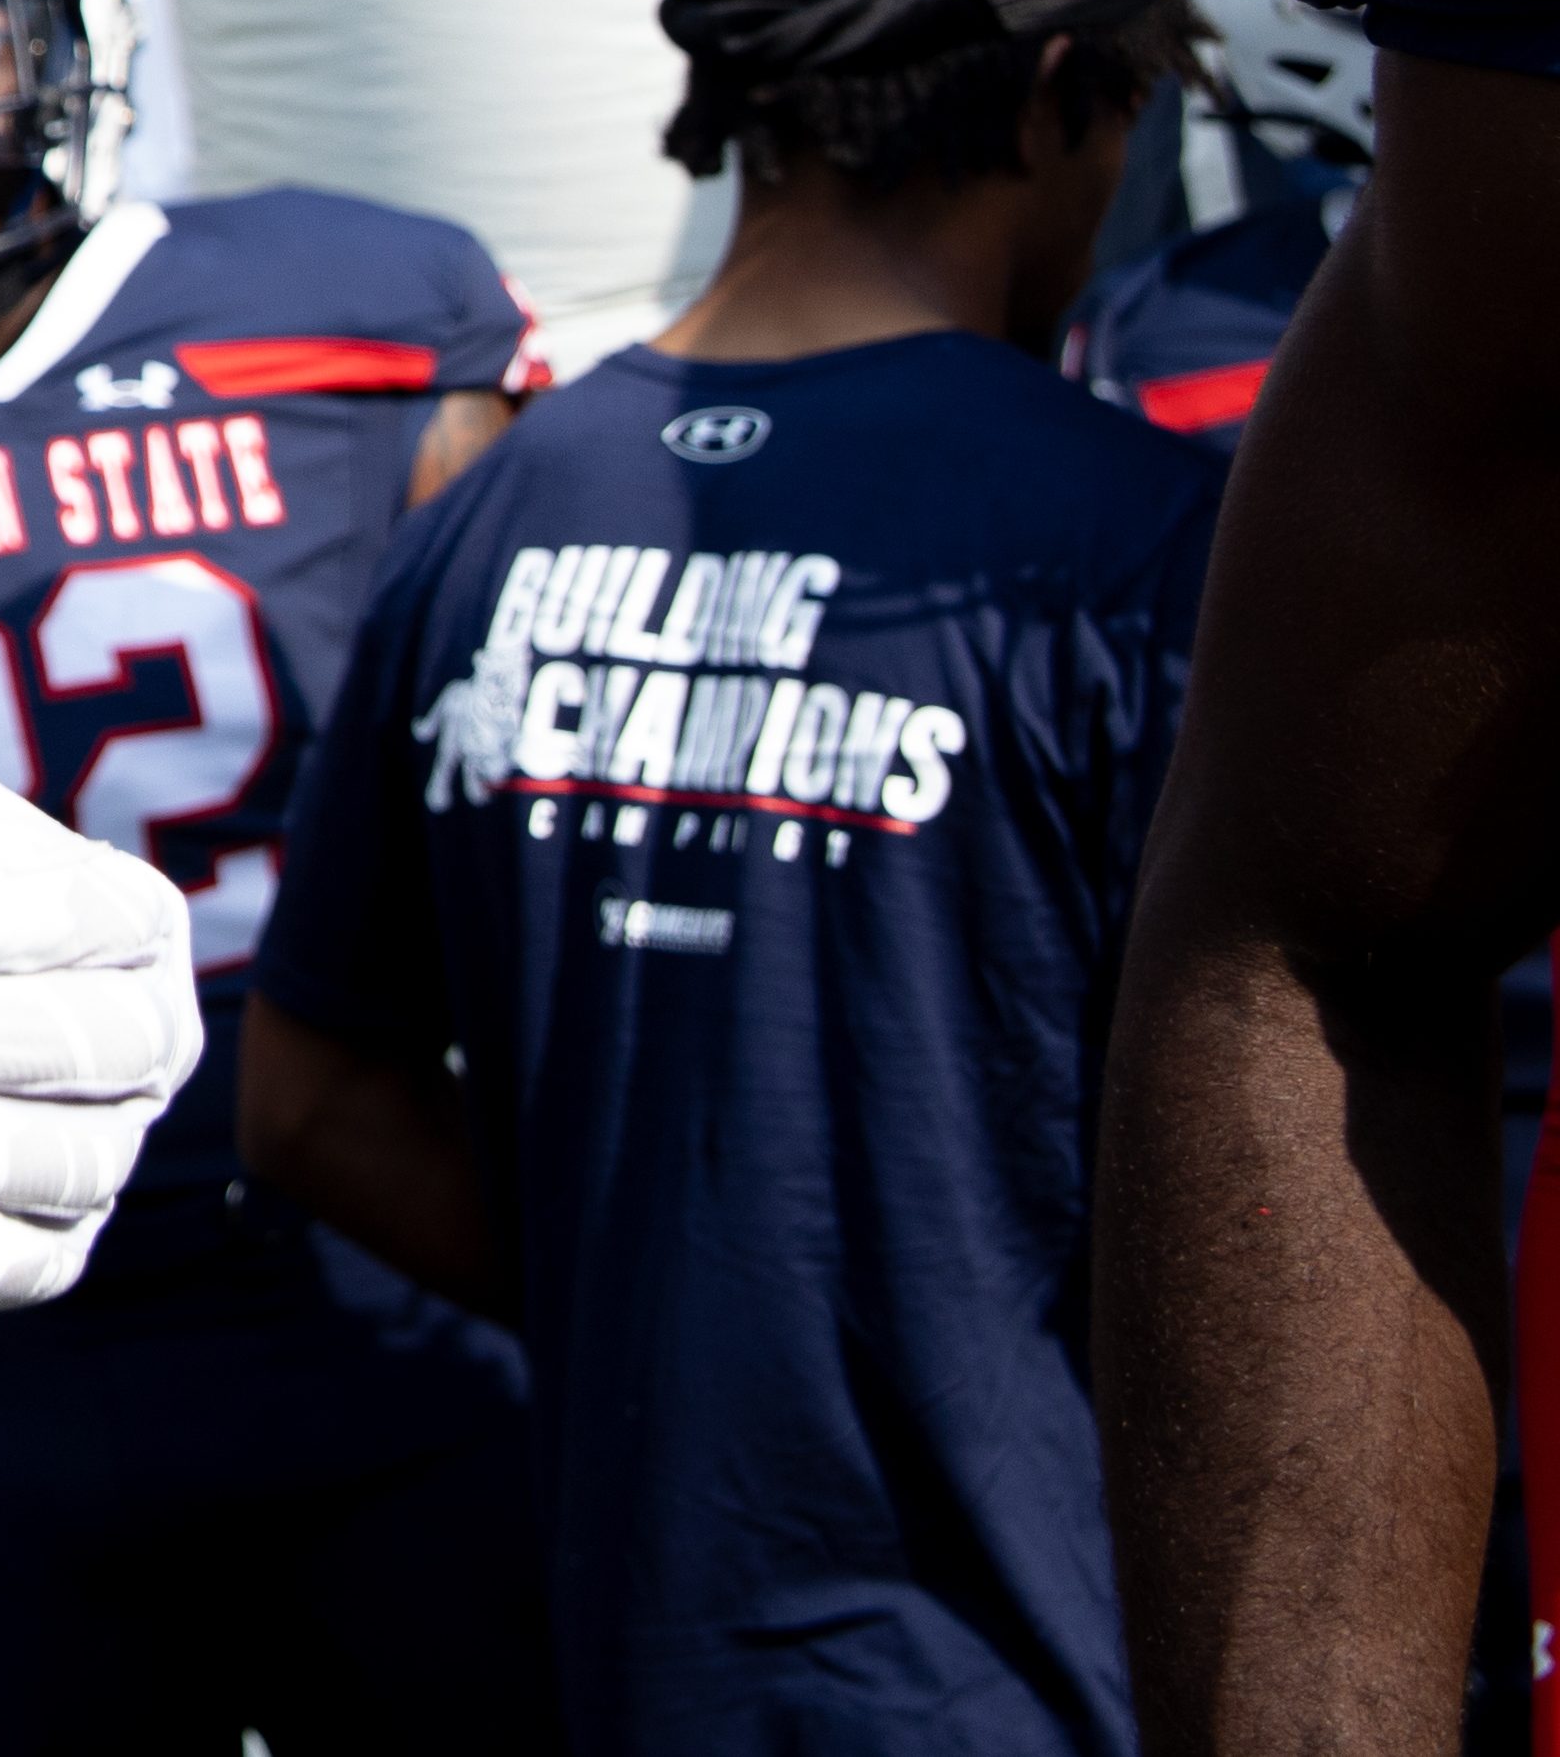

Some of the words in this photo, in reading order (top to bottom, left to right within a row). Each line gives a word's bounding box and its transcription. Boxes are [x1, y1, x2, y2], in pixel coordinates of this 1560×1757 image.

[47, 413, 287, 546] STATE
[486, 545, 840, 670] BUILDING
[516, 661, 965, 824] CHAMPIONS
